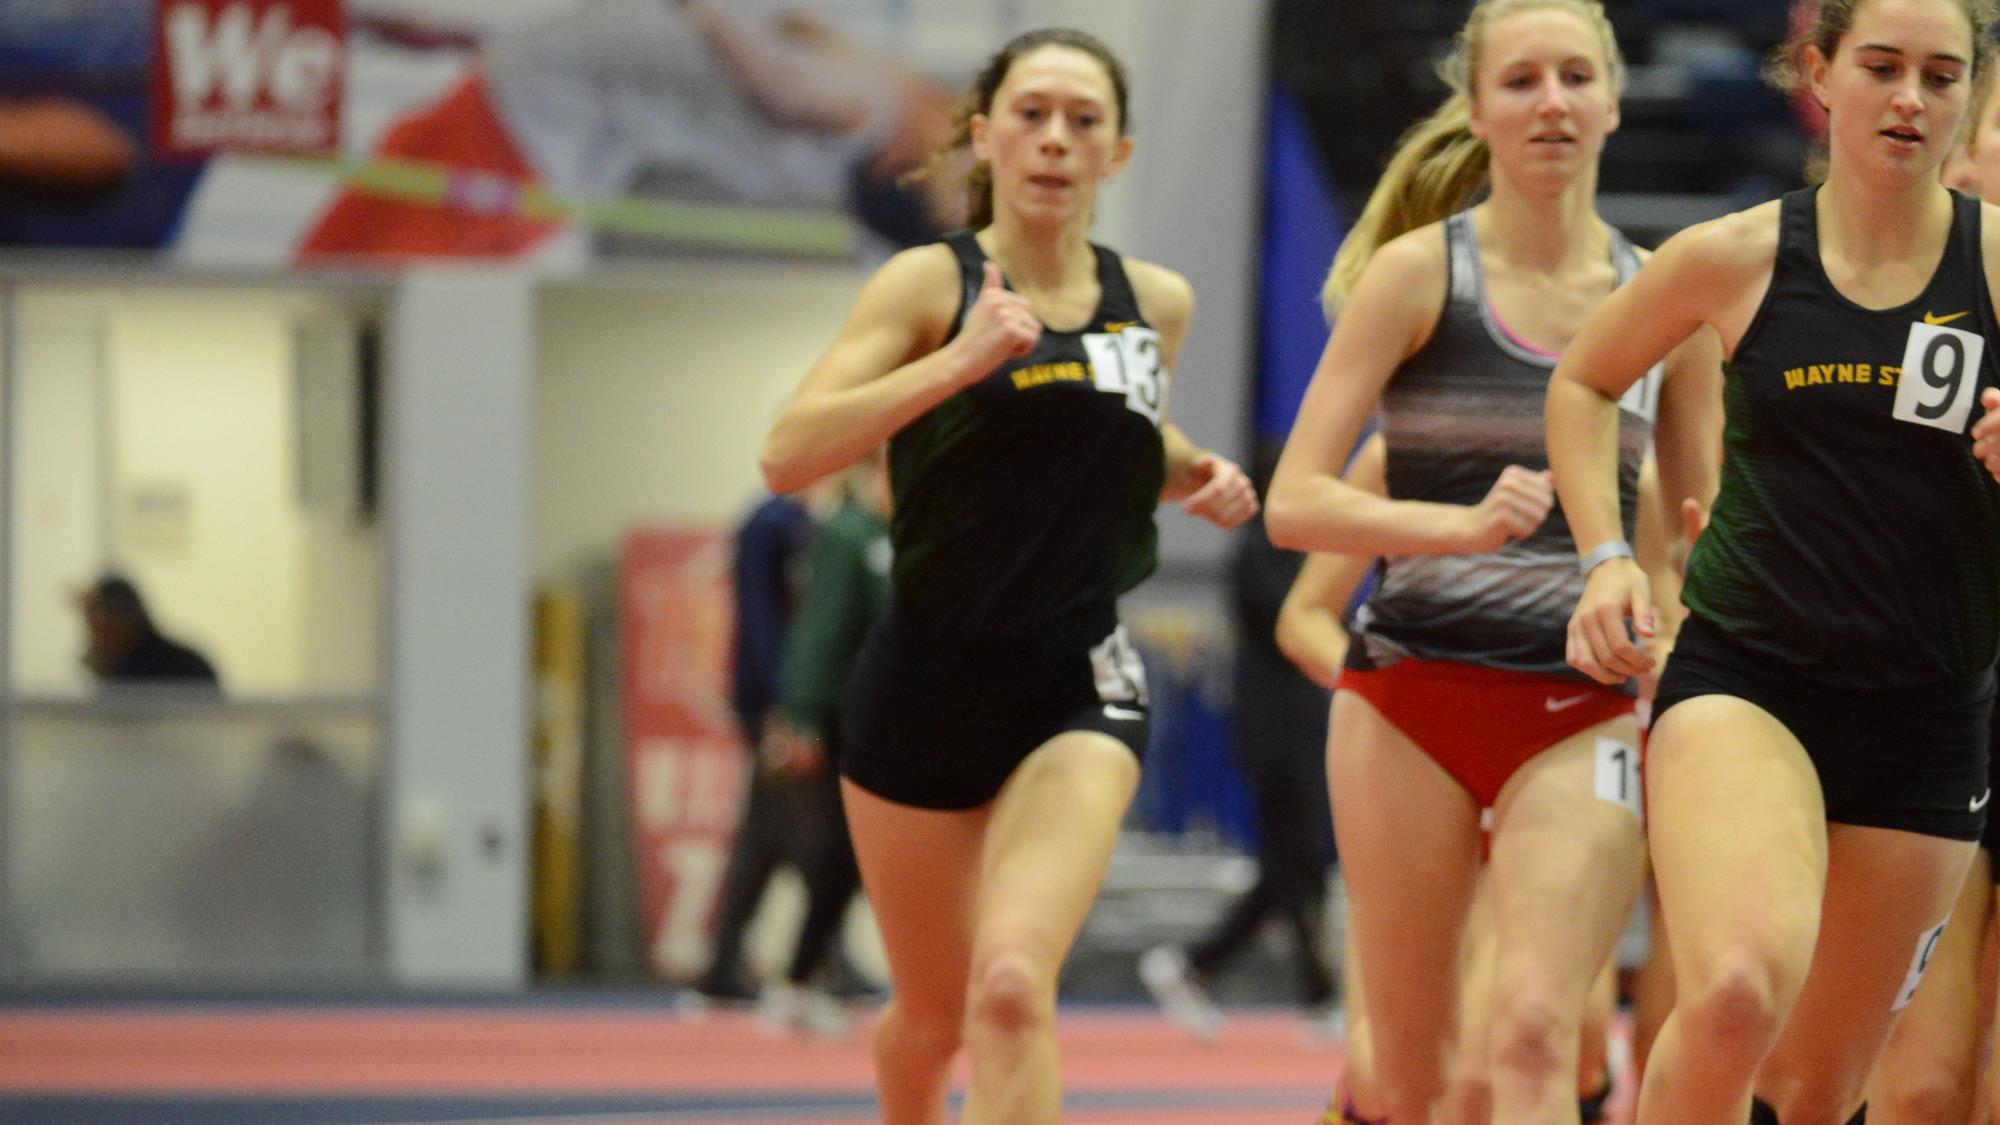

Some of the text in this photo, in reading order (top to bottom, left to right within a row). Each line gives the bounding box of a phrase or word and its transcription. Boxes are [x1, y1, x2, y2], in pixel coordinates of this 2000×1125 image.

[166, 2, 337, 110] We
[1105, 336, 1161, 411] 13
[1783, 363, 1871, 390] WAYNE
[1915, 333, 1965, 420] 9
